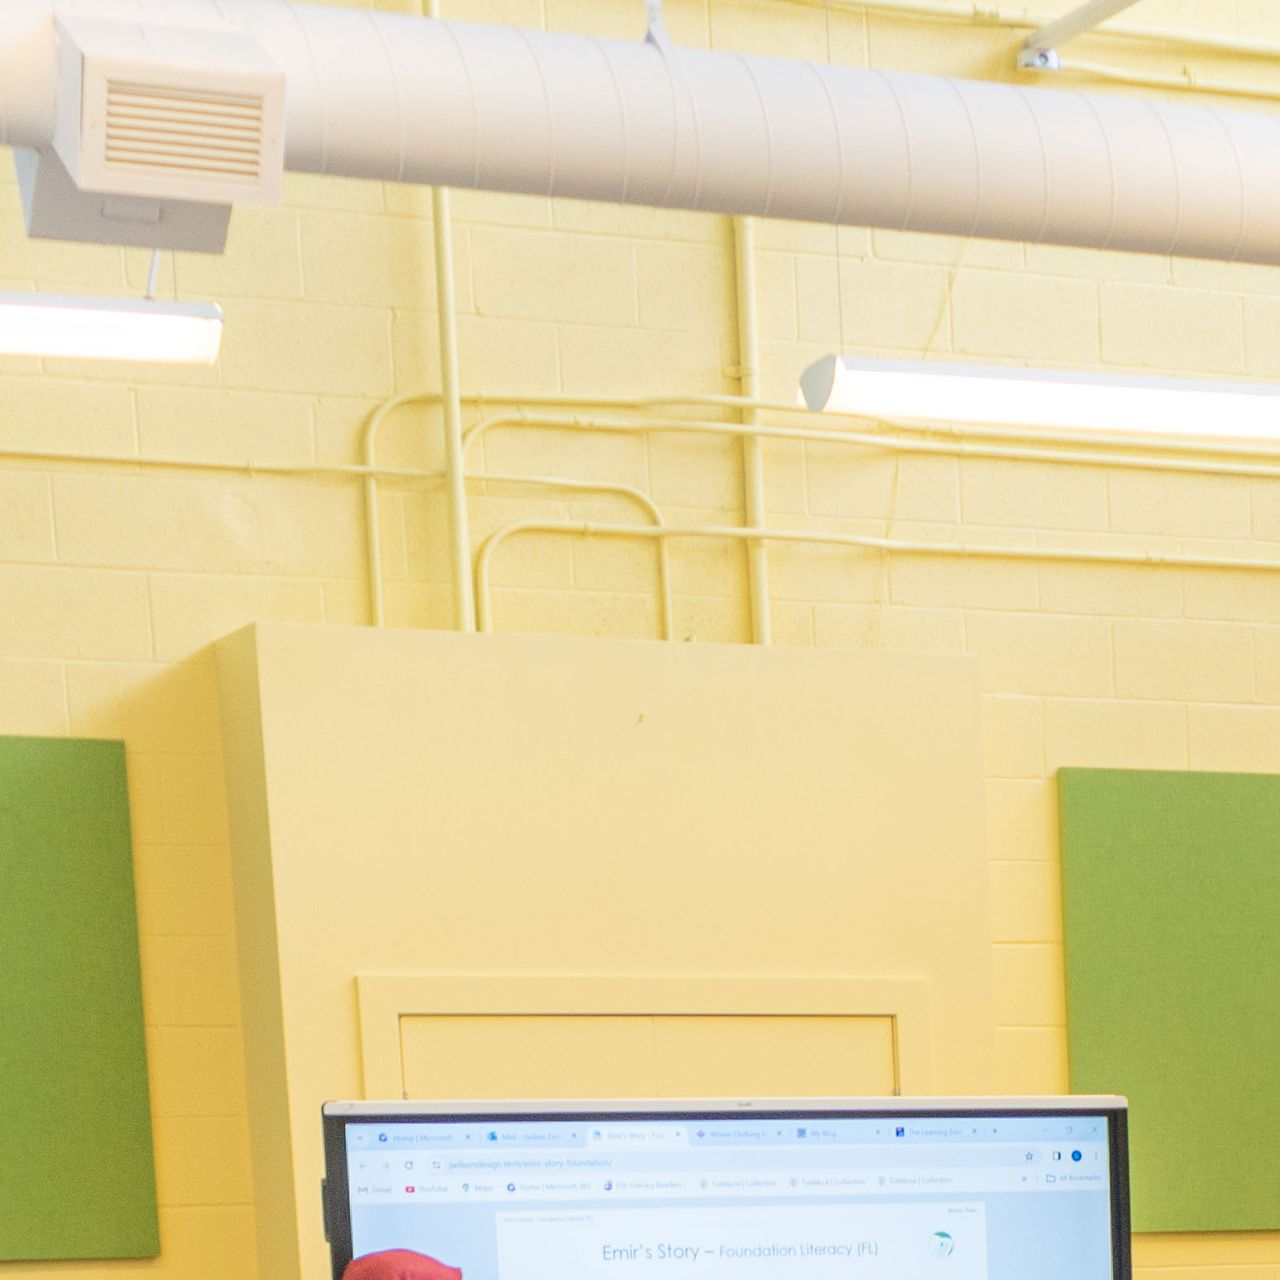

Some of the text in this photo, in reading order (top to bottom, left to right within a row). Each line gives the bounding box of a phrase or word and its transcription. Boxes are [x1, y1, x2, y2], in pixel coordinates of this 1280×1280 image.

[602, 1243, 653, 1261] Emir's
[657, 1241, 700, 1262] Story
[719, 1242, 797, 1259] Foundation
[800, 1241, 853, 1258] Literacy
[857, 1240, 879, 1258] (FL)
